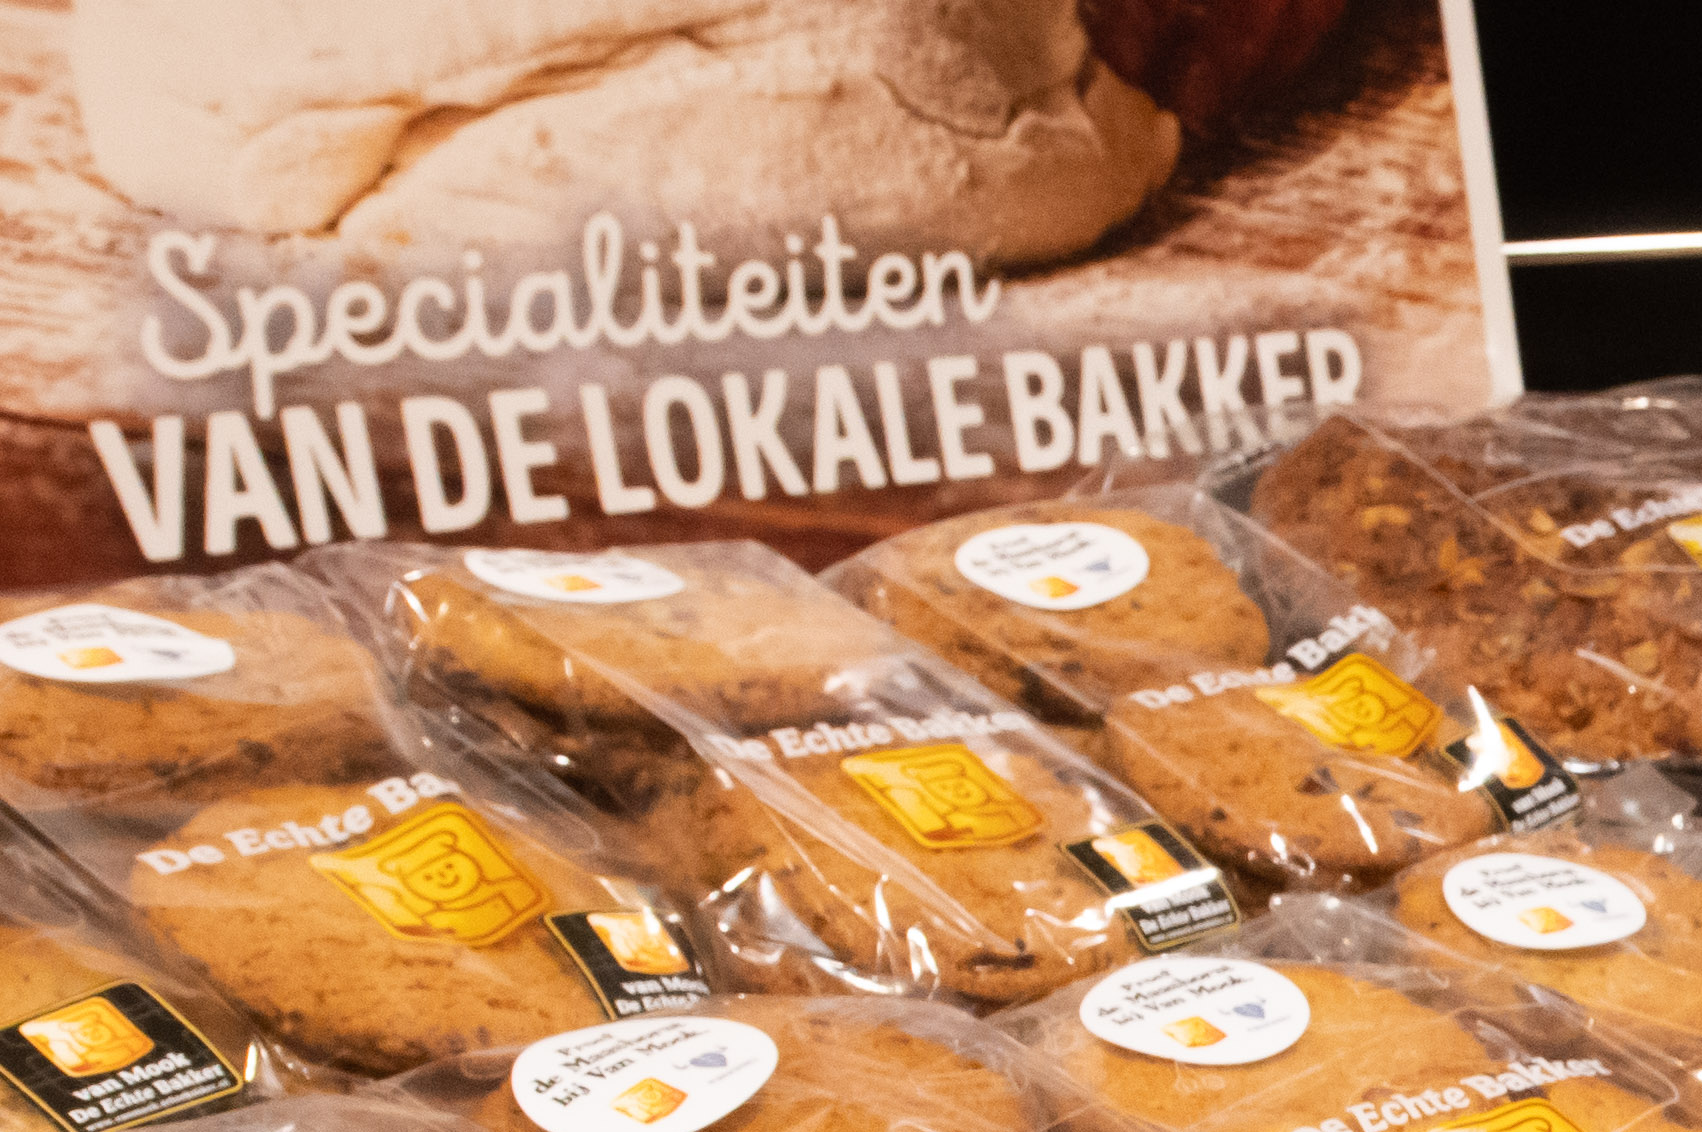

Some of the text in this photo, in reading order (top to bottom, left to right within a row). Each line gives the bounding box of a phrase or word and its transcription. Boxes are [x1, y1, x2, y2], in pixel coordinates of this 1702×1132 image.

[140, 211, 1000, 421] Specialiteiten
[89, 329, 1362, 562] VAN DE LOKALE BAKKER
[768, 721, 895, 758] Echte
[137, 804, 374, 876] De Echte
[68, 1105, 102, 1125] De
[99, 1086, 157, 1115] Echte
[152, 1063, 227, 1096] Bakker
[72, 1051, 193, 1101] van Mook
[586, 1057, 636, 1080] Van
[1459, 1056, 1613, 1100] Bakker
